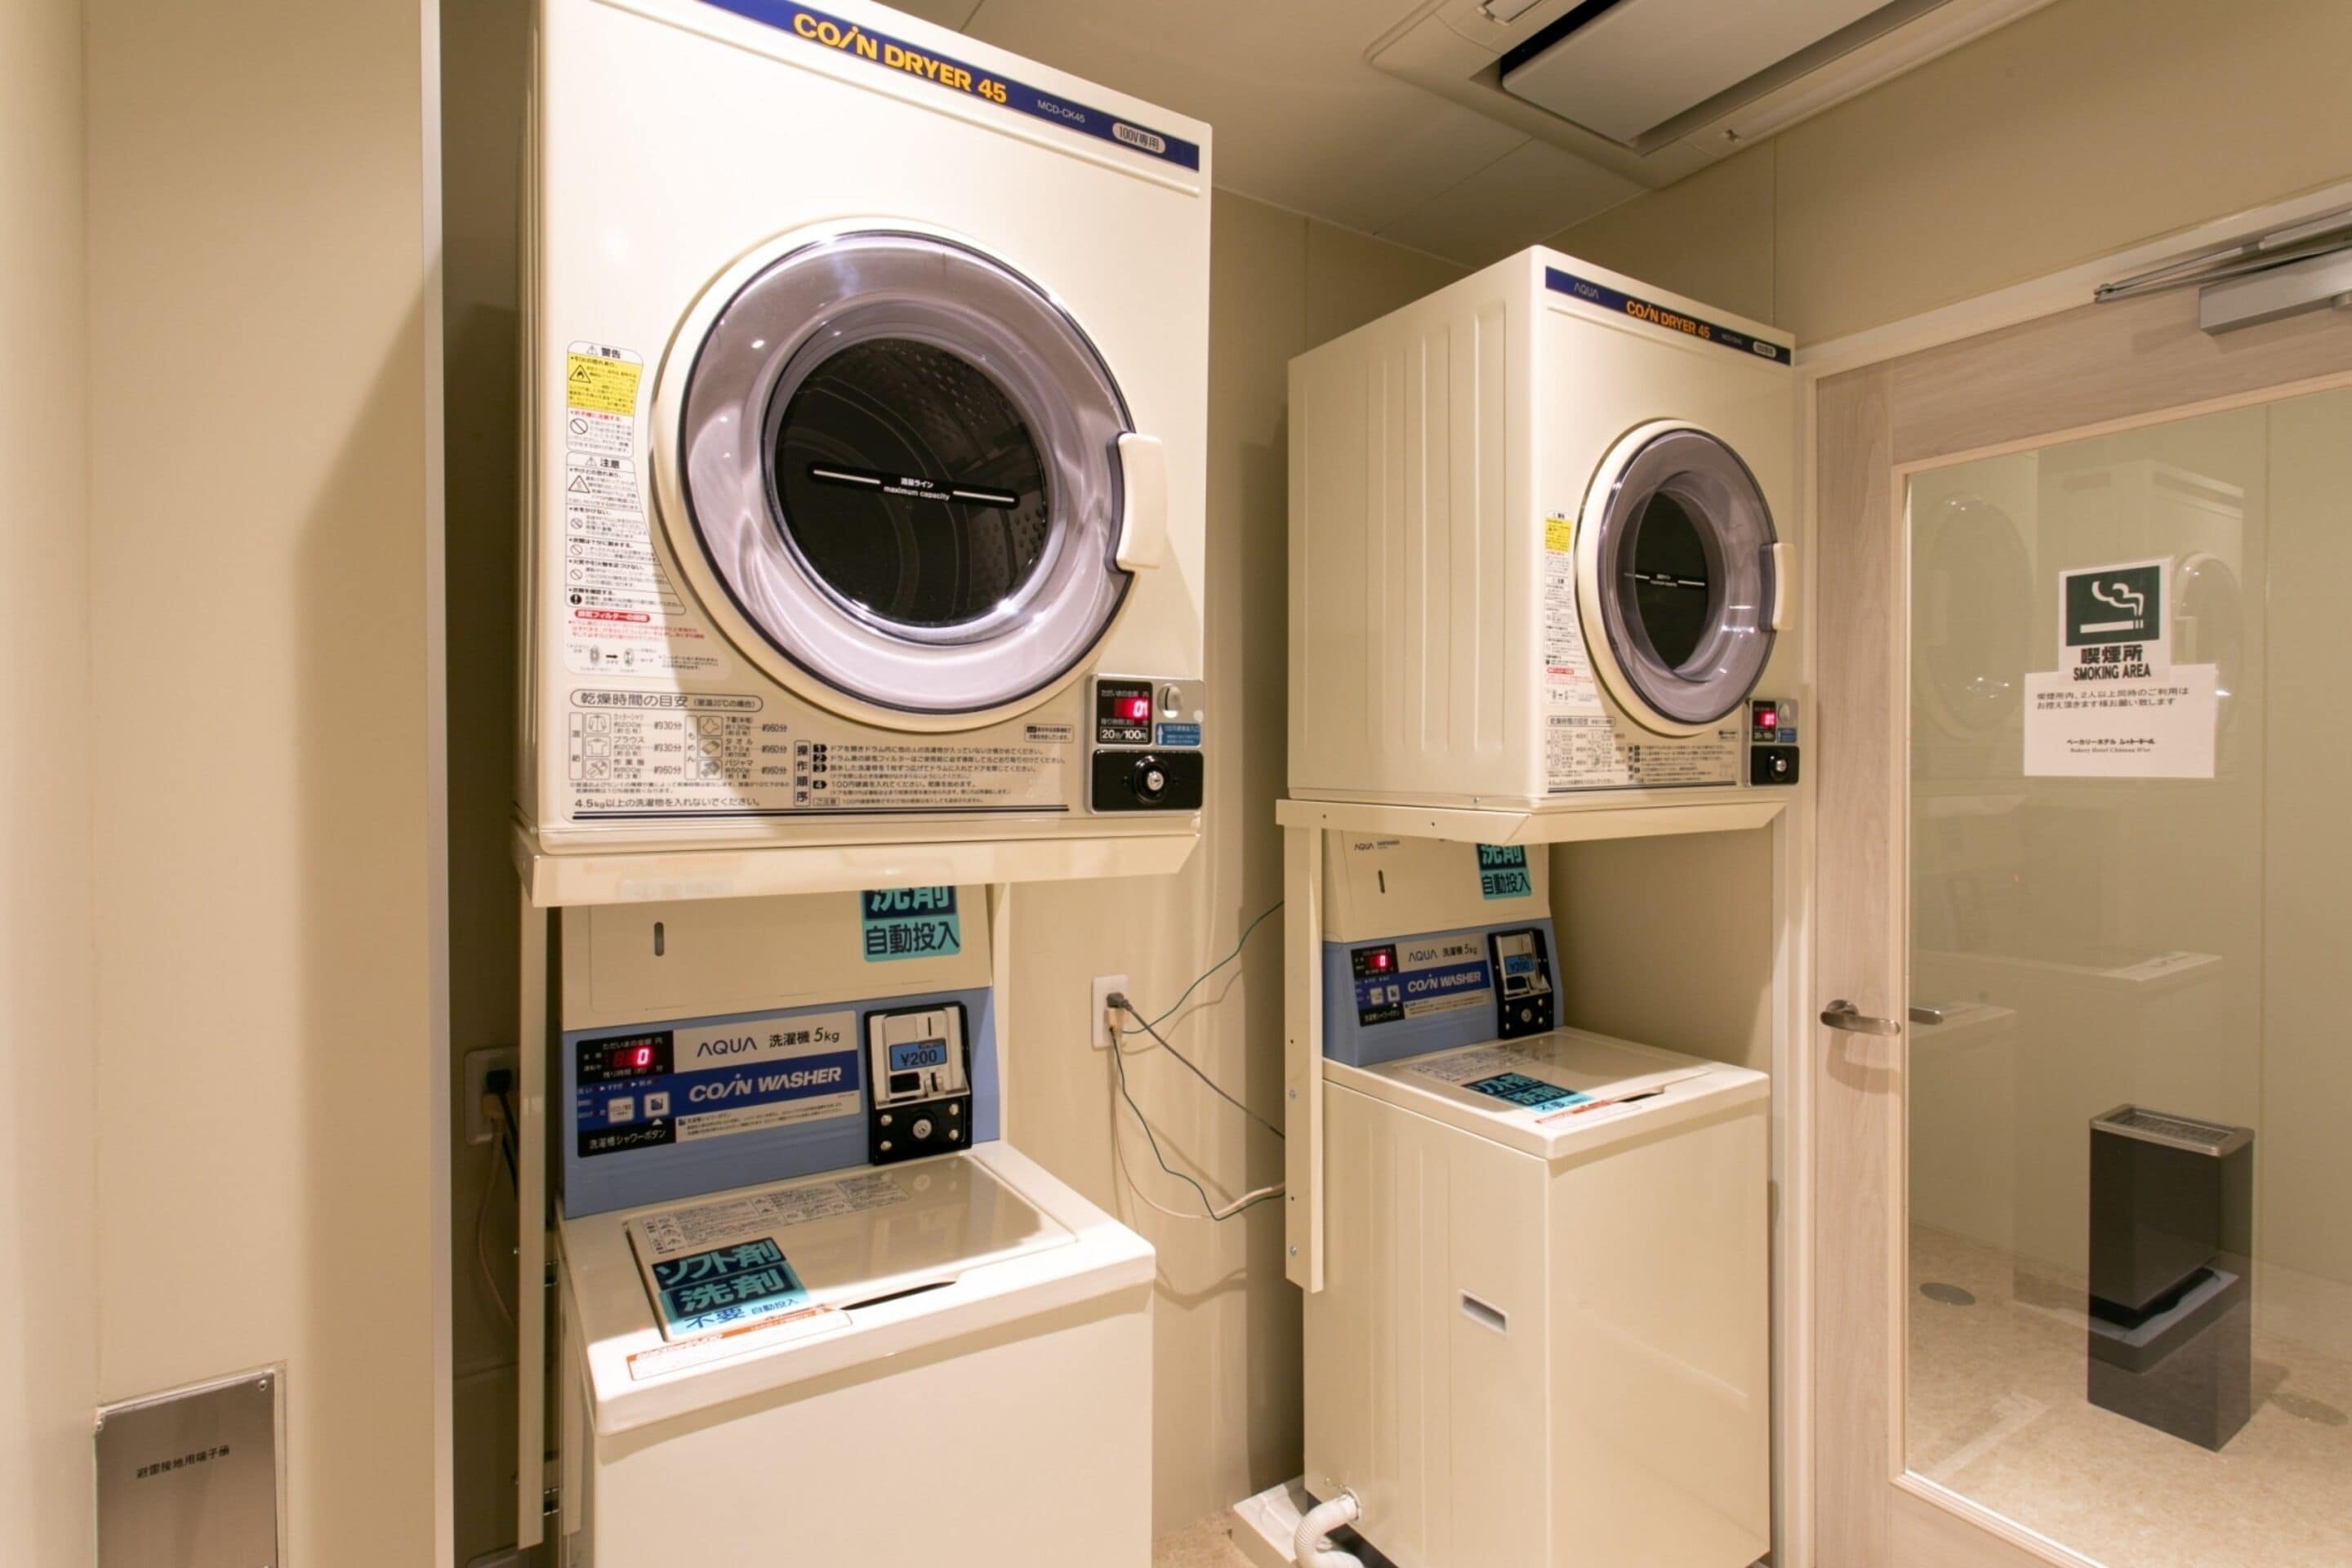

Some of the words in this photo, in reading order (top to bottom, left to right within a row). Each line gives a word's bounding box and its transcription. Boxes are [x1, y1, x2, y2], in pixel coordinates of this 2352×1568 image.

[884, 45, 971, 92] DRYER
[978, 78, 1007, 104] 45
[1037, 99, 1085, 123] MCD-CK45
[1118, 126, 1160, 151] 100V専用
[1575, 283, 1599, 300] AQUA
[1661, 312, 1696, 335] DRYER
[1699, 325, 1710, 340] 45
[884, 486, 918, 497] maximum
[920, 491, 950, 501] capacity
[2080, 644, 2143, 665] 喫煙所
[2074, 666, 2118, 681] SMOKING
[2123, 664, 2151, 678] AREA
[581, 692, 688, 708] 乾燥時間の目安
[796, 745, 808, 803] 操作順序
[1482, 872, 1531, 895] 自動投入
[866, 921, 959, 955] 自動投入
[1408, 948, 1438, 962] AQUA
[1441, 970, 1481, 987] WASHER
[697, 1037, 758, 1058] AQUA
[769, 1031, 809, 1047] 洗濯機
[814, 1027, 840, 1044] 5kg
[637, 1049, 648, 1064] 0
[901, 1049, 938, 1067] ¥200
[758, 1067, 841, 1093] WASHER
[657, 1239, 782, 1284] ソフト剤
[679, 1269, 785, 1312] 洗剤
[686, 1306, 745, 1329] 不要
[751, 1298, 799, 1315] 自動投入
